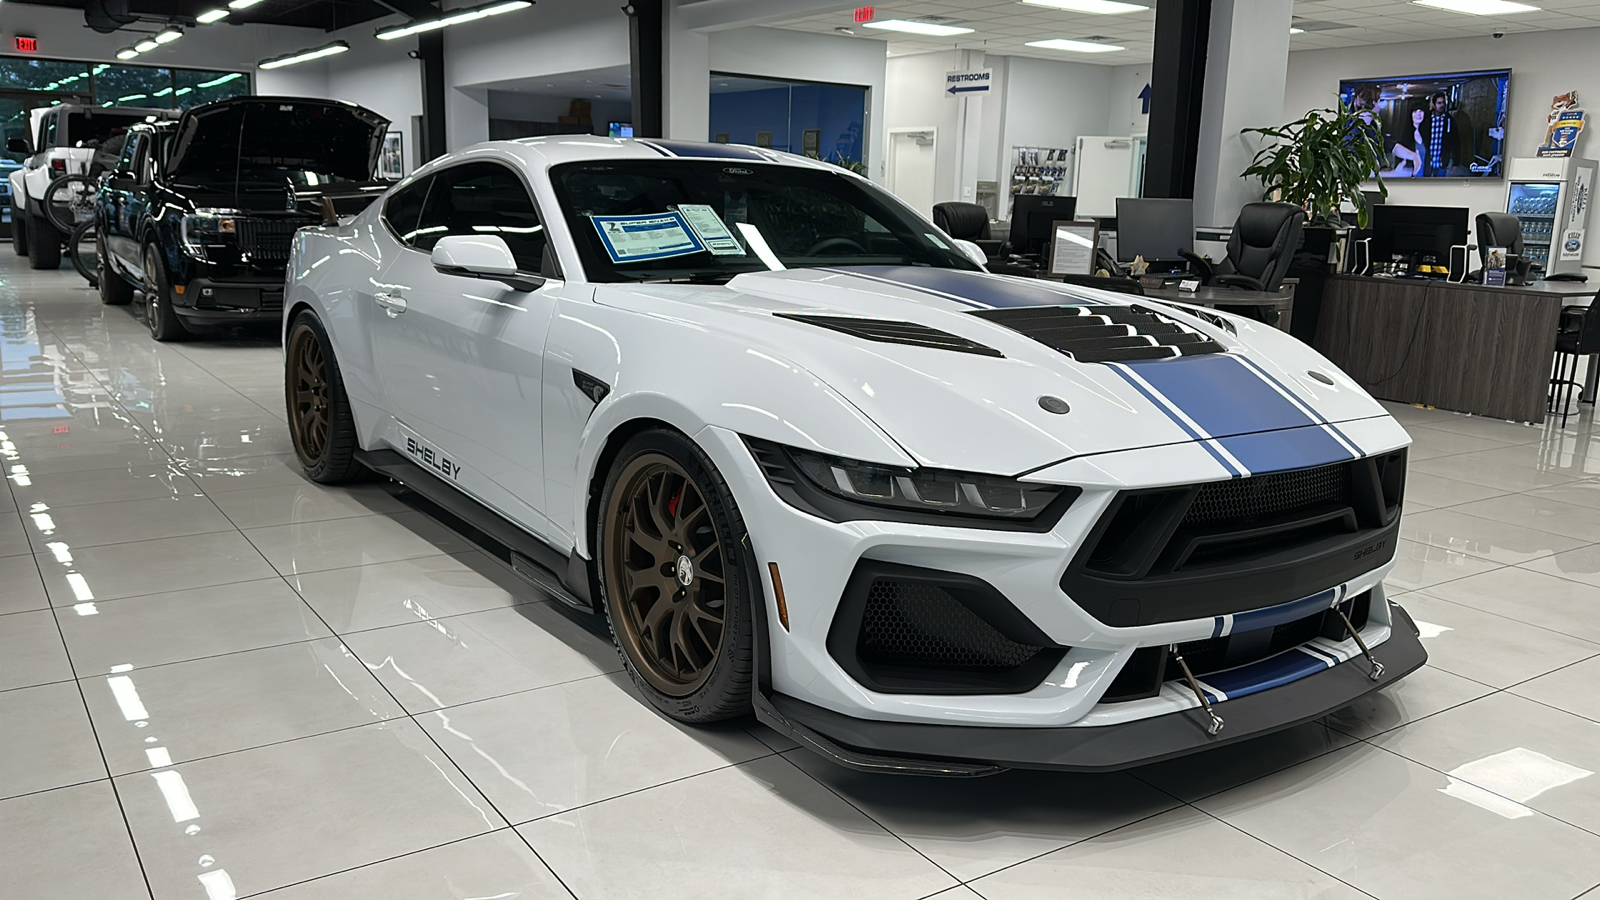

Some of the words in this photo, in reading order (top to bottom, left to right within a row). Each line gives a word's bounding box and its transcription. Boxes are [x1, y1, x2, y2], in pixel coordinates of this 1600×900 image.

[18, 38, 35, 51] EXIT
[947, 72, 990, 82] RESTROOMS
[407, 437, 461, 480] SHELBY
[1353, 539, 1387, 561] SHELBY
